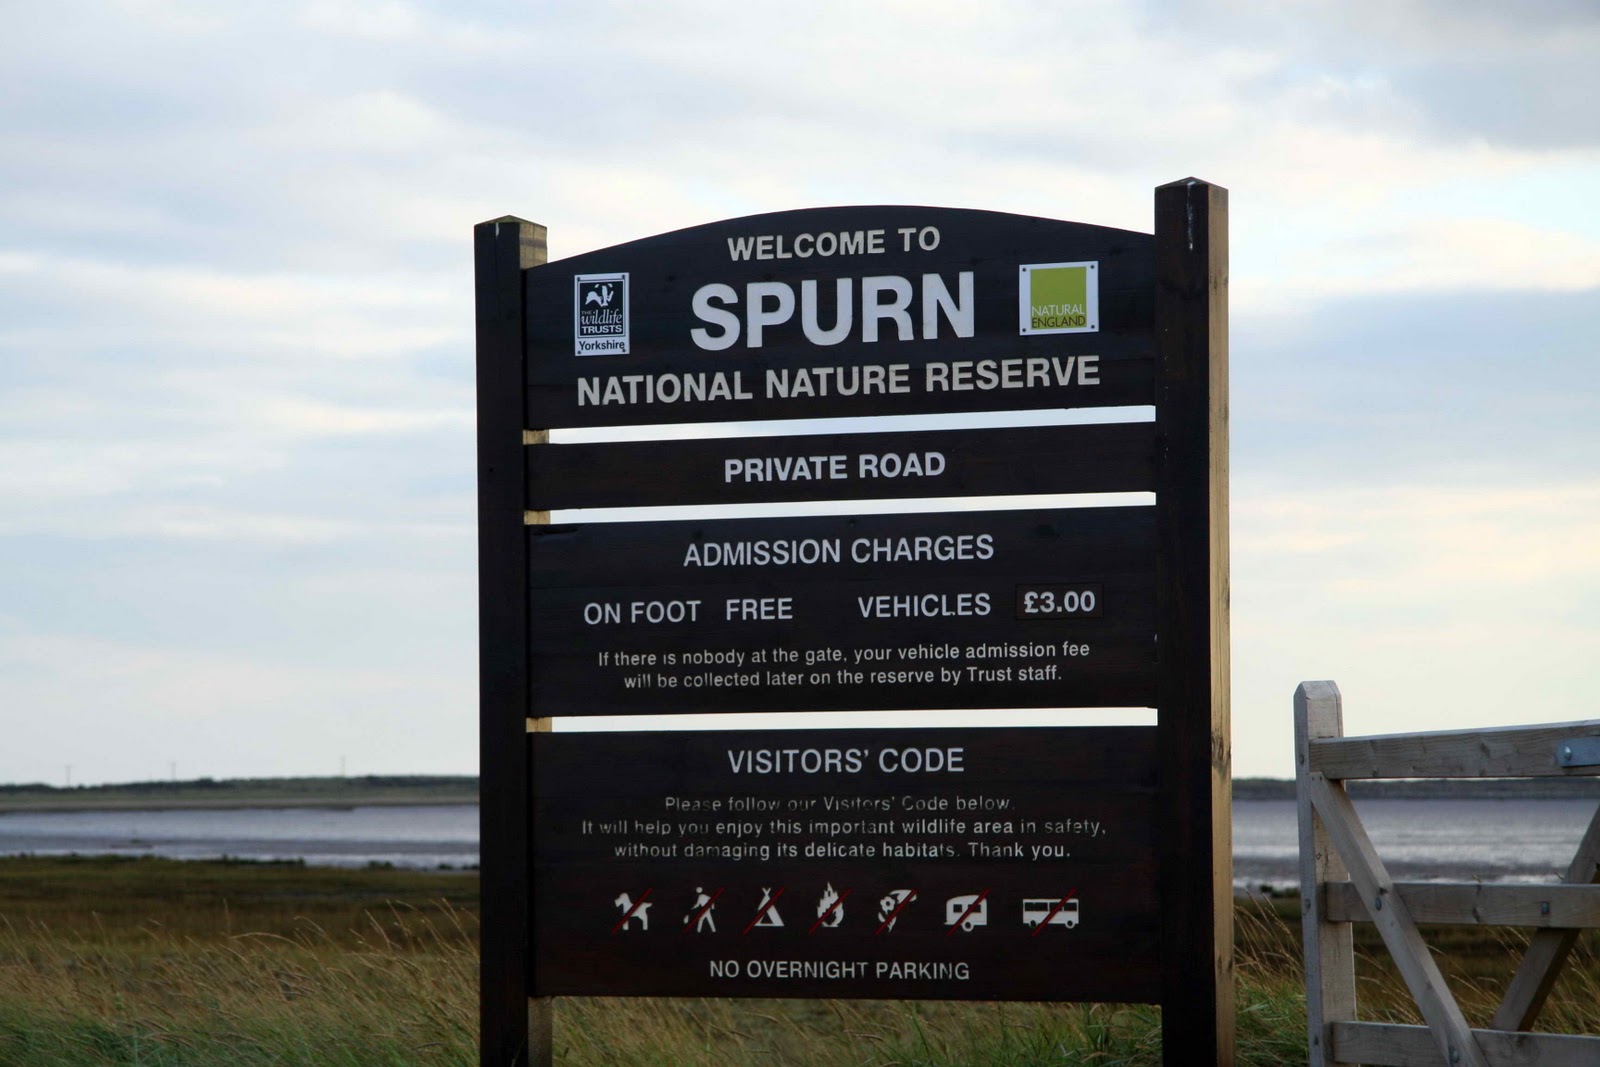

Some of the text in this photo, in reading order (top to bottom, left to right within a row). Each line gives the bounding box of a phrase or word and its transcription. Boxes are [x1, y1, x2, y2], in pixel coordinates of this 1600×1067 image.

[728, 226, 940, 261] WELCOME TO
[581, 309, 622, 324] wildlife
[691, 272, 974, 350] SPURN
[1032, 304, 1085, 315] NATURAL
[582, 325, 622, 333] TRUSTS
[1032, 315, 1086, 328] ENGLAND
[579, 340, 625, 350] Yorkshire
[578, 356, 1100, 406] NATIONAL NATURE RESERVE
[725, 452, 945, 482] PRIVATE ROAD
[684, 534, 994, 566] ADMISSION CHARGES
[584, 591, 1095, 624] ON FOOT FREE VEHICLES £3.00
[599, 641, 1090, 667] If there is nobody at the gate, your vehicle admission fee
[624, 665, 1061, 688] will be collected later on the reserve by Trust staff.
[879, 748, 964, 772] CODE
[666, 797, 721, 811] Please
[728, 797, 780, 811] follow
[788, 800, 816, 810] our
[902, 796, 948, 810] Code
[583, 819, 1105, 838] It will help you enjoy this important wildlife area in safety,
[615, 842, 1070, 861] without damaging its delicate habitats. Thank you.
[710, 960, 970, 979] NO OVERNIGHT PARKING
